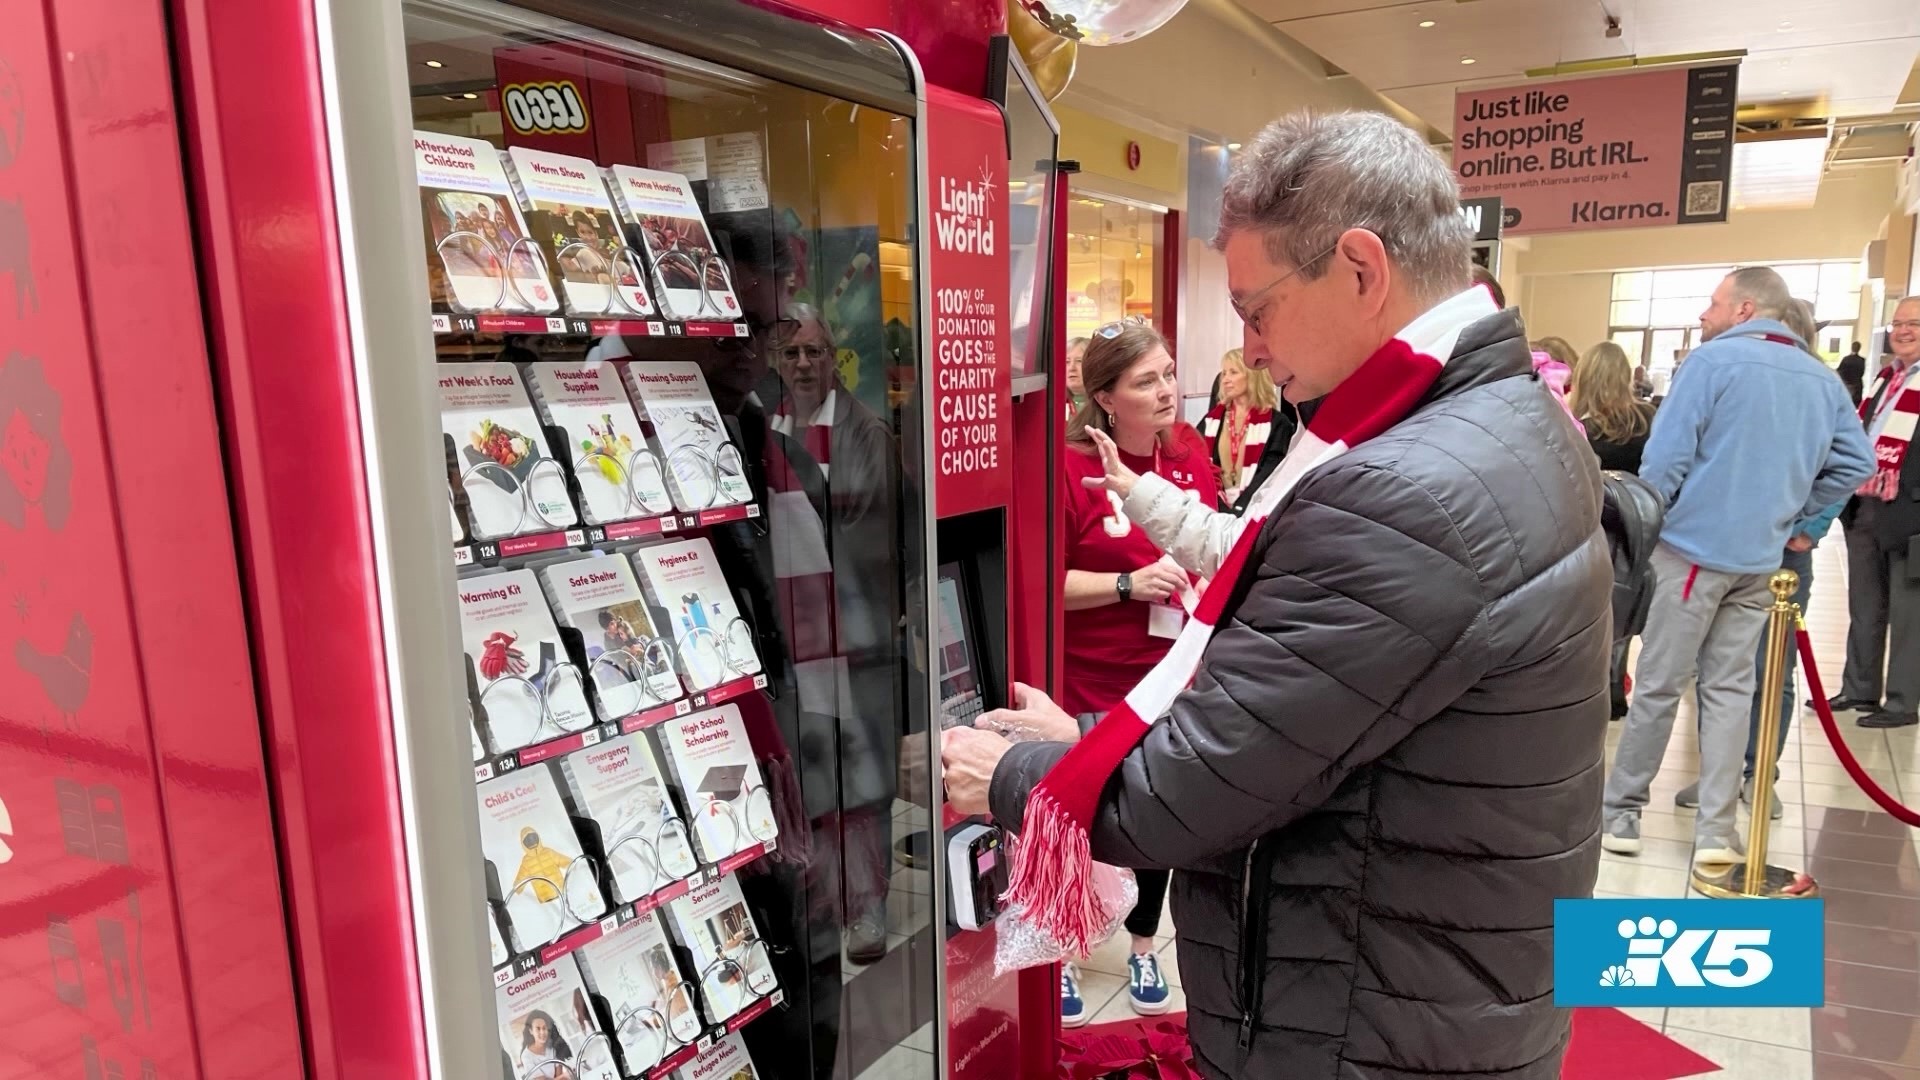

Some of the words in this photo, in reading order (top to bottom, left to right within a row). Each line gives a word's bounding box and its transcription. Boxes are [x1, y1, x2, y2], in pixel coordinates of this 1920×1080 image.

[1463, 95, 1521, 122] Just
[1524, 91, 1569, 116] like
[1461, 118, 1585, 150] shopping
[414, 139, 475, 157] Afterschool
[424, 154, 475, 170] Childcare
[1459, 153, 1545, 178] online.
[1550, 145, 1598, 170] But
[1601, 141, 1649, 166] IRL.
[530, 161, 559, 175] Warm
[559, 166, 586, 180] Shoes
[1519, 180, 1539, 188] with
[1540, 177, 1571, 186] Klarna
[1572, 175, 1590, 184] and
[1592, 173, 1608, 184] pay
[1611, 171, 1620, 180] in
[628, 177, 653, 190] Home
[653, 180, 684, 196] Heating
[940, 176, 986, 225] Light
[1571, 200, 1670, 224] Klarna.
[934, 211, 995, 256] World
[937, 287, 974, 315] 100%
[974, 288, 985, 300] OF
[974, 302, 995, 315] YOUR
[458, 318, 475, 331] 114
[549, 320, 561, 329] $25
[572, 321, 587, 333] 116
[938, 317, 996, 336] DONATION
[938, 339, 983, 365] GOES
[984, 340, 994, 351] TO
[984, 353, 996, 364] THE
[438, 376, 454, 388] rst
[453, 376, 489, 388] Week's
[490, 375, 514, 387] Food
[554, 369, 599, 380] Household
[639, 372, 669, 385] Housing
[670, 373, 698, 384] Support
[939, 368, 997, 391] CHARITY
[563, 382, 600, 394] Supplies
[940, 393, 997, 423] CAUSE
[941, 427, 959, 448] OF
[962, 423, 997, 446] YOUR
[941, 446, 998, 475] CHOICE
[479, 546, 496, 557] 124
[567, 534, 582, 543] $100
[590, 530, 604, 541] 126
[658, 555, 688, 568] Hygiene
[687, 551, 699, 561] Kit
[569, 575, 589, 588] Safe
[589, 571, 617, 584] Shelter
[459, 588, 508, 604] Warming
[507, 584, 522, 595] Kit
[681, 722, 700, 736] High
[699, 715, 725, 730] School
[685, 729, 729, 748] Scholarship
[585, 745, 630, 765] Emergency
[596, 756, 629, 774] Support
[476, 767, 488, 777] $10
[499, 757, 515, 771] 134
[484, 791, 515, 808] Child's
[515, 783, 537, 797] Coat
[691, 886, 720, 905] Services
[497, 972, 510, 983] $25
[520, 956, 536, 970] 144
[506, 967, 558, 996] Counseling
[715, 1025, 727, 1038] 158
[692, 1057, 719, 1079] Refugee
[718, 1043, 738, 1061] Meals
[696, 1039, 727, 1063] Ukrainian
